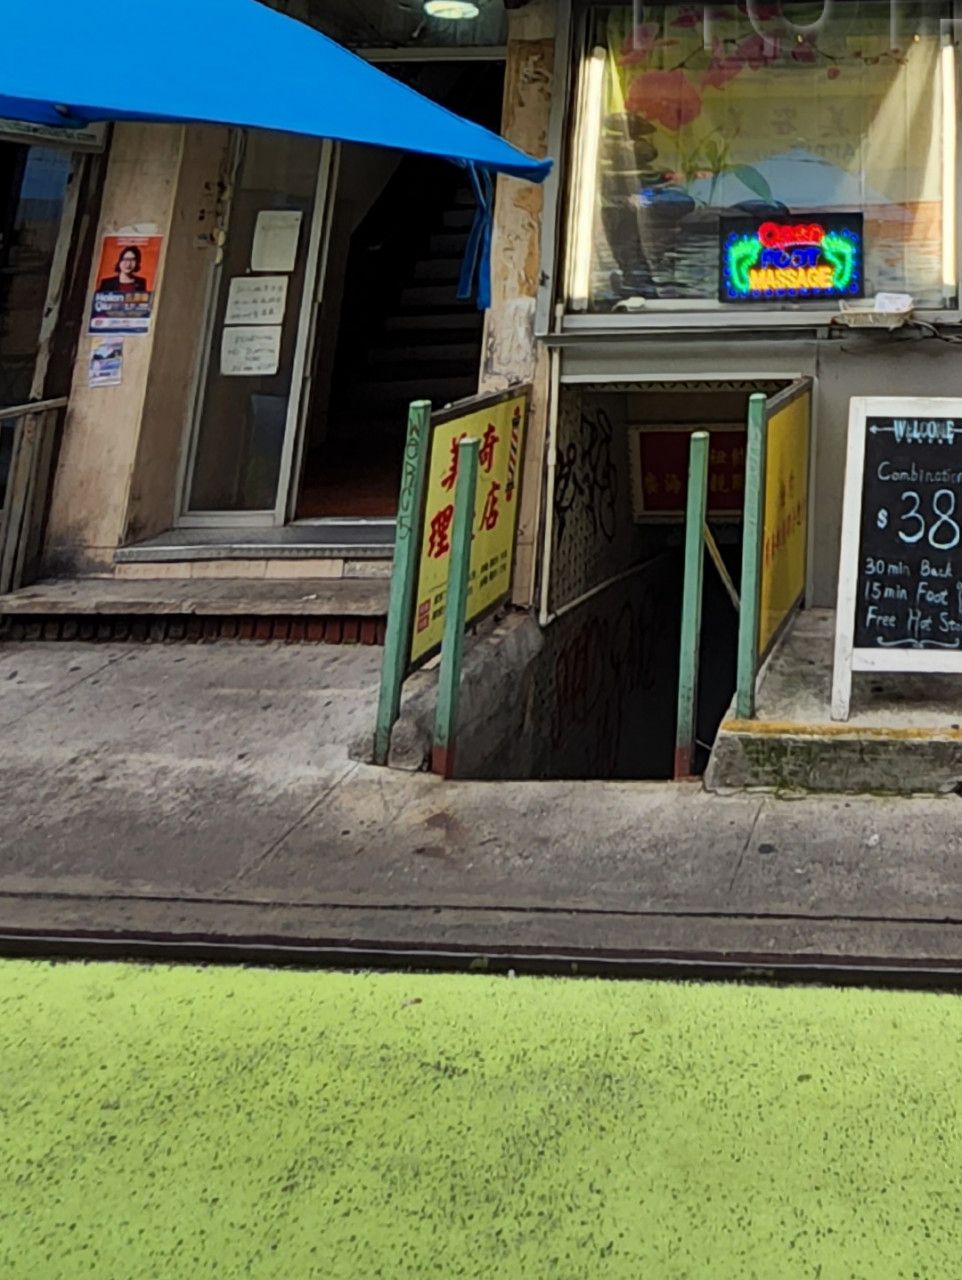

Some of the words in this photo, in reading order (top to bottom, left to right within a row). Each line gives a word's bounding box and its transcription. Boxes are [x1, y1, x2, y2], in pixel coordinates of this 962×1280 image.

[761, 247, 821, 269] FOOT
[749, 265, 835, 290] MASSAGE
[898, 489, 960, 550] 38
[920, 560, 953, 578] Back
[916, 581, 948, 605] Foot
[866, 606, 897, 628] Free
